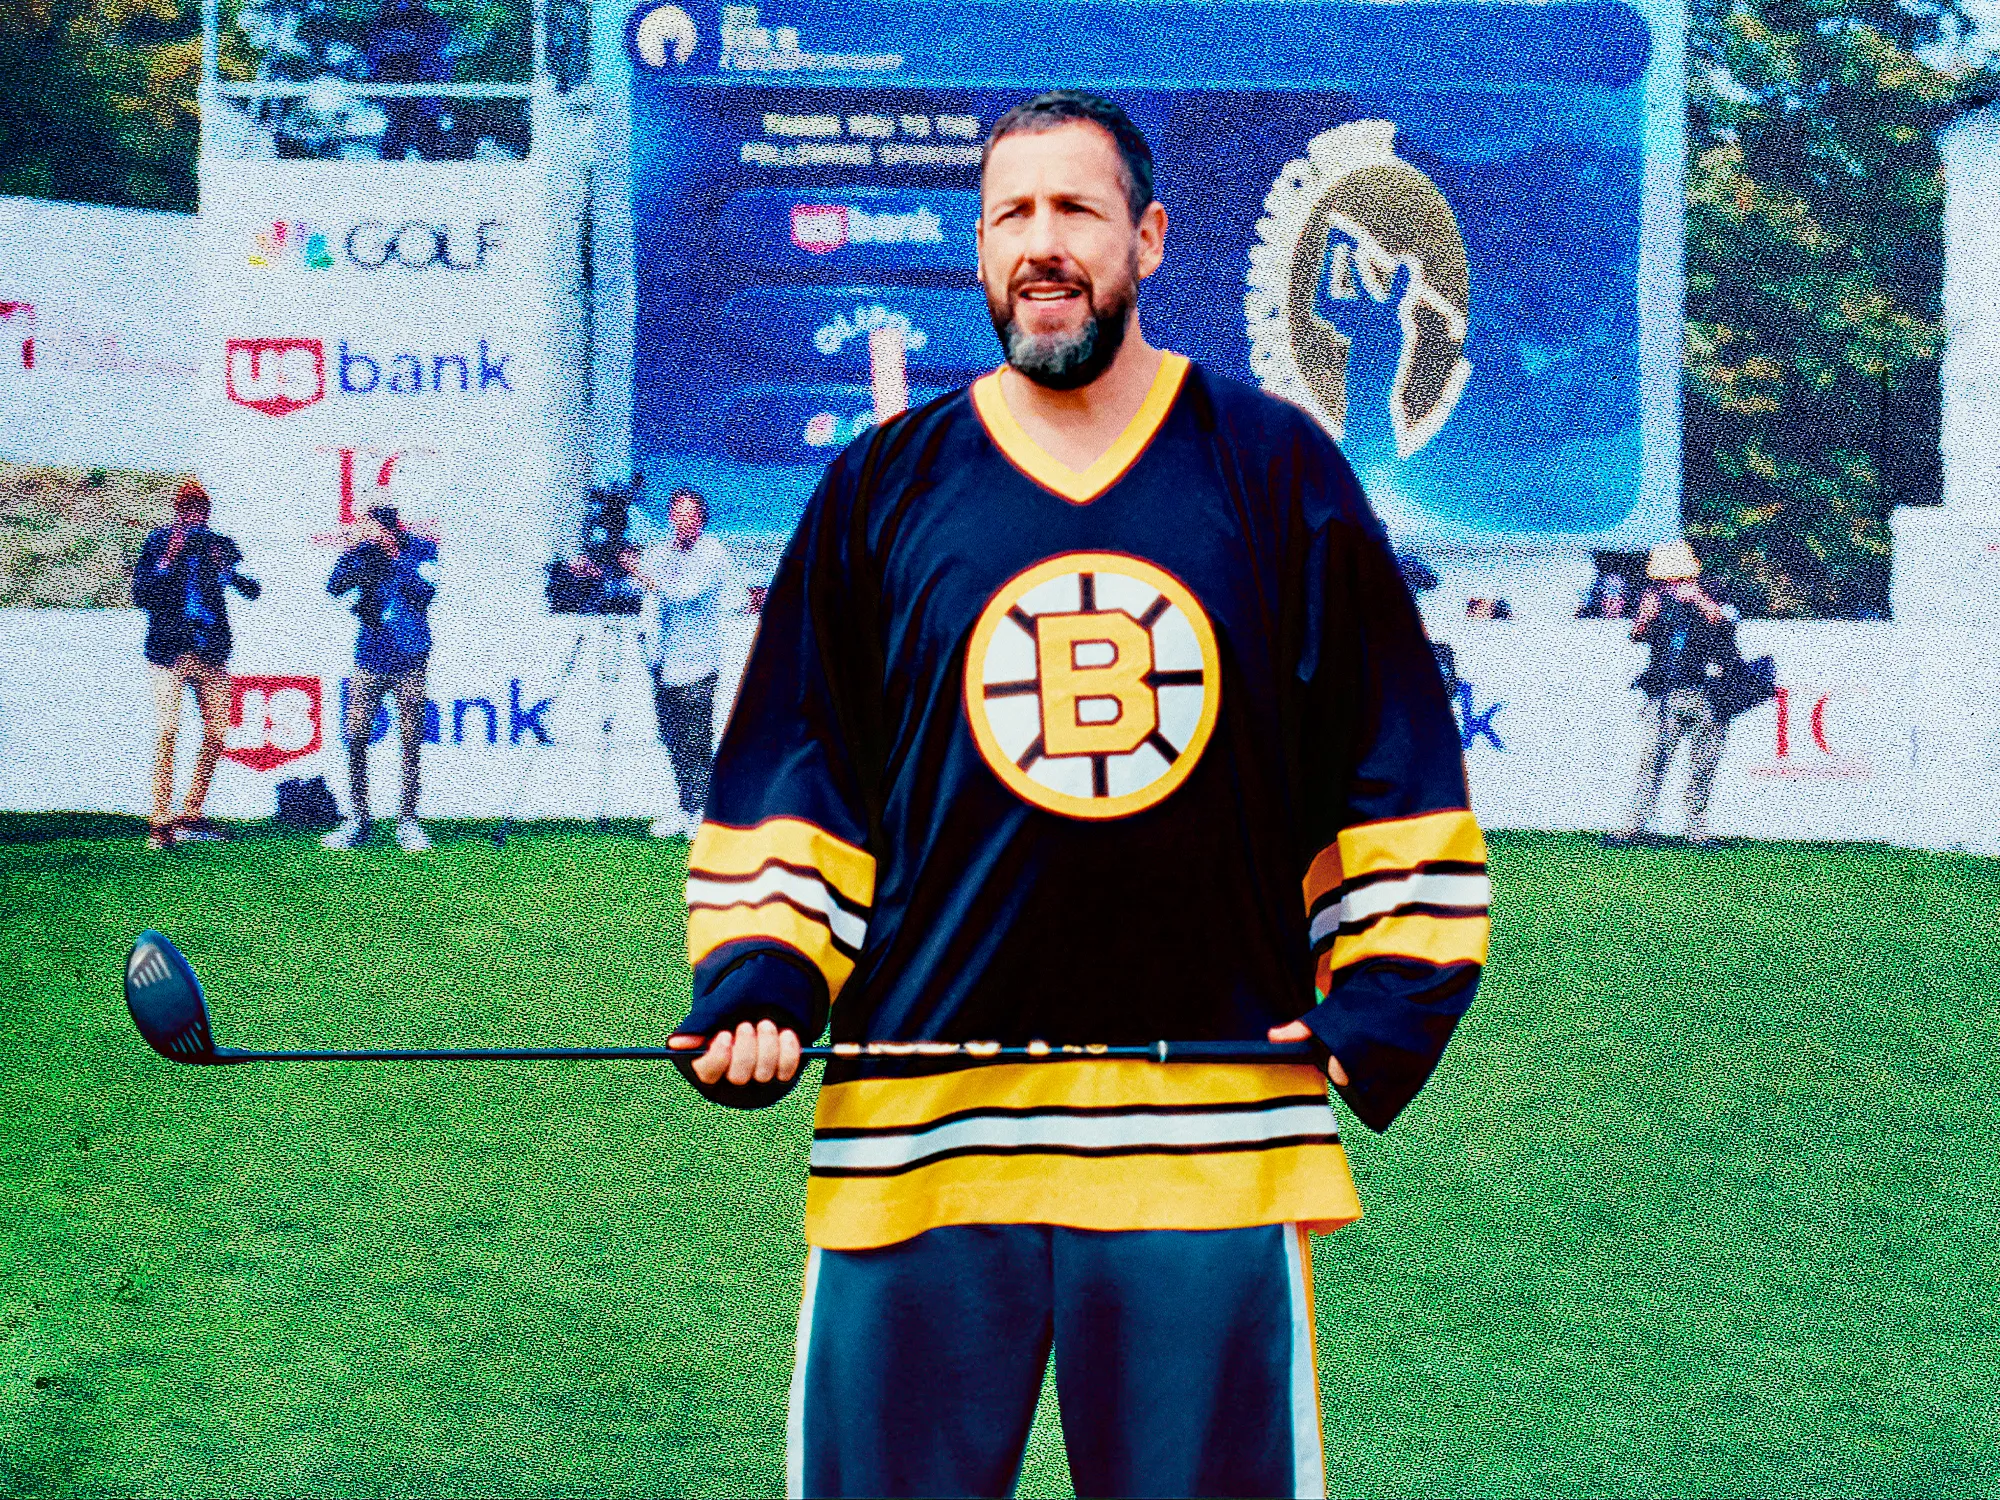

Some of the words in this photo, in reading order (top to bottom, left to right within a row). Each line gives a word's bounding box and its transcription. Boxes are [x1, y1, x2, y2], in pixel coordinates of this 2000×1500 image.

[345, 219, 504, 270] GOLF
[338, 337, 512, 394] bank
[1033, 608, 1161, 760] B
